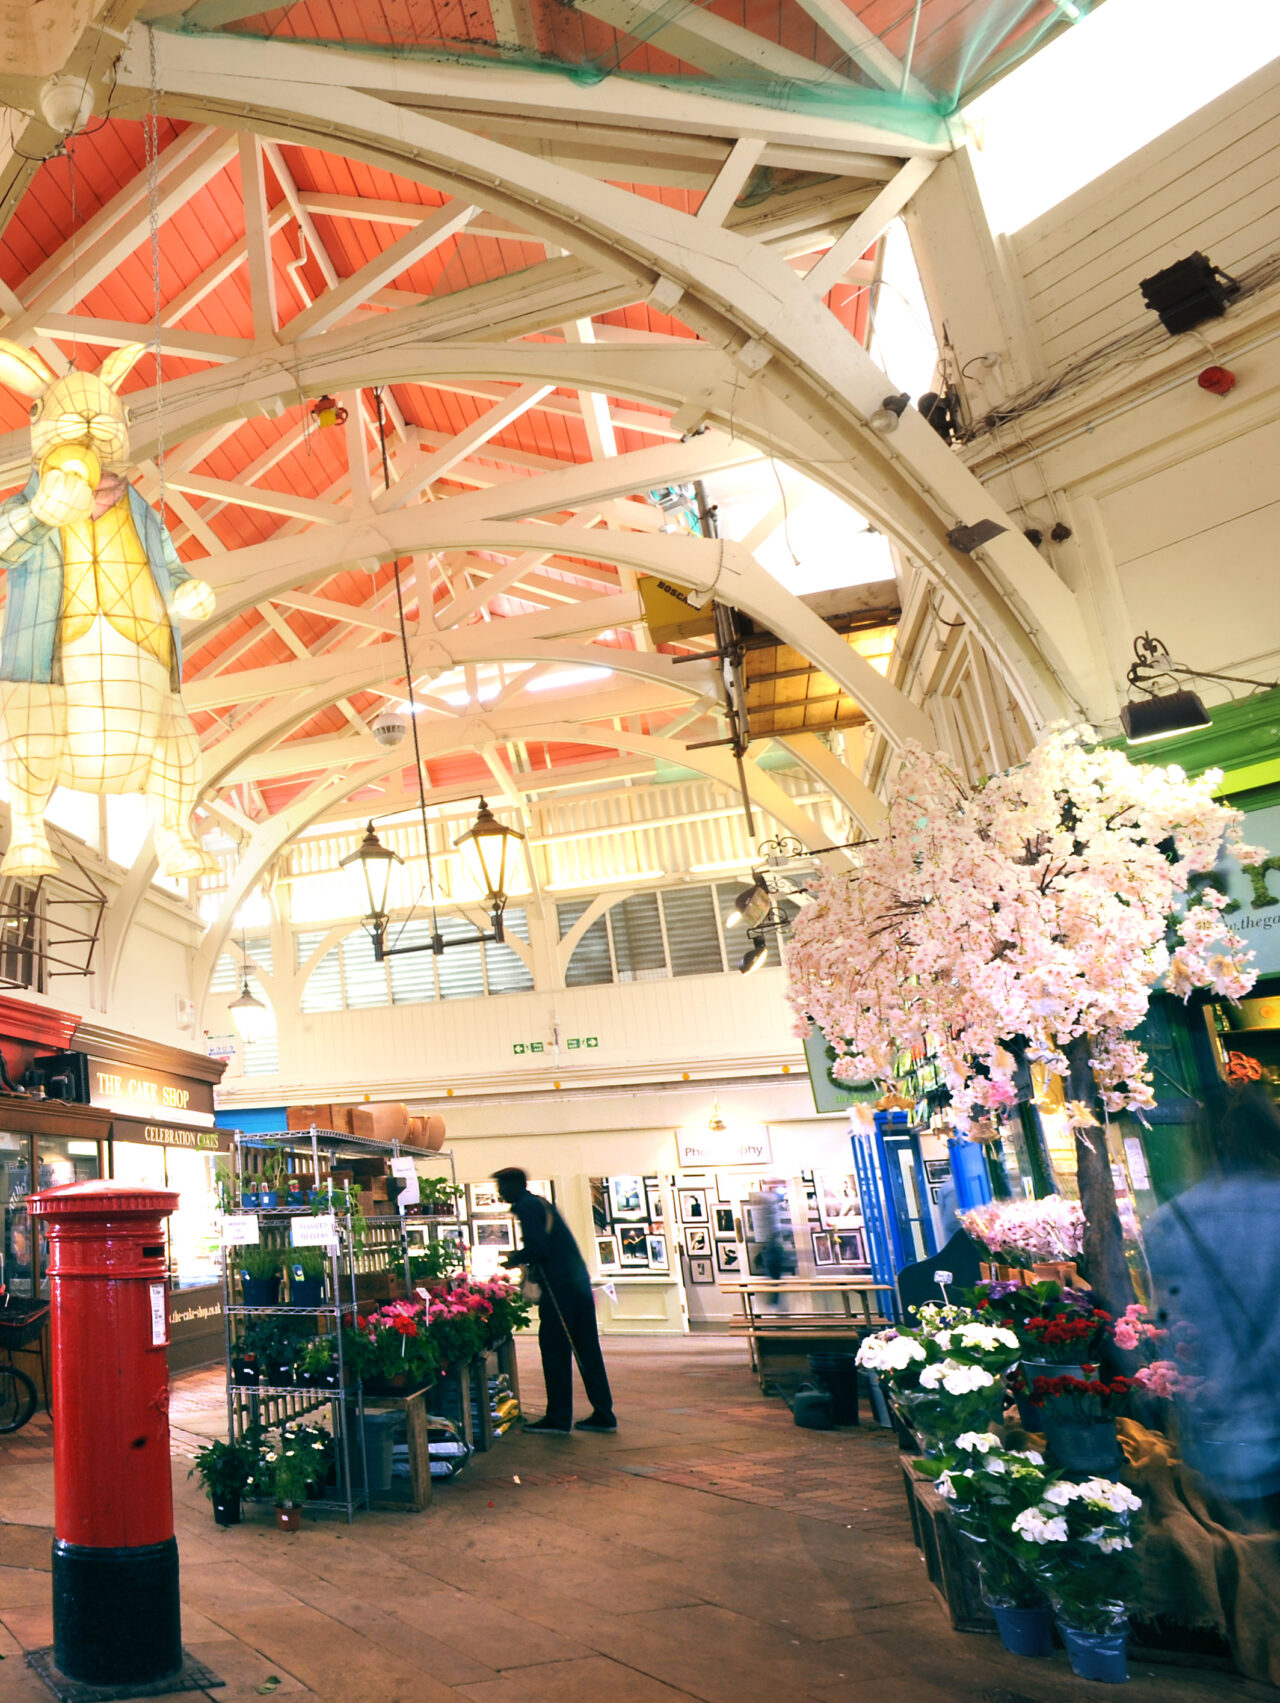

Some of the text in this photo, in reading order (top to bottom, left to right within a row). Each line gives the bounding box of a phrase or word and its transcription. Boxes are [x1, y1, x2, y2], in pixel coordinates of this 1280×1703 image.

[656, 580, 701, 611] BOSCA
[96, 1072, 190, 1109] THE CAKE SHOP
[144, 1126, 196, 1146] CELEBRATION
